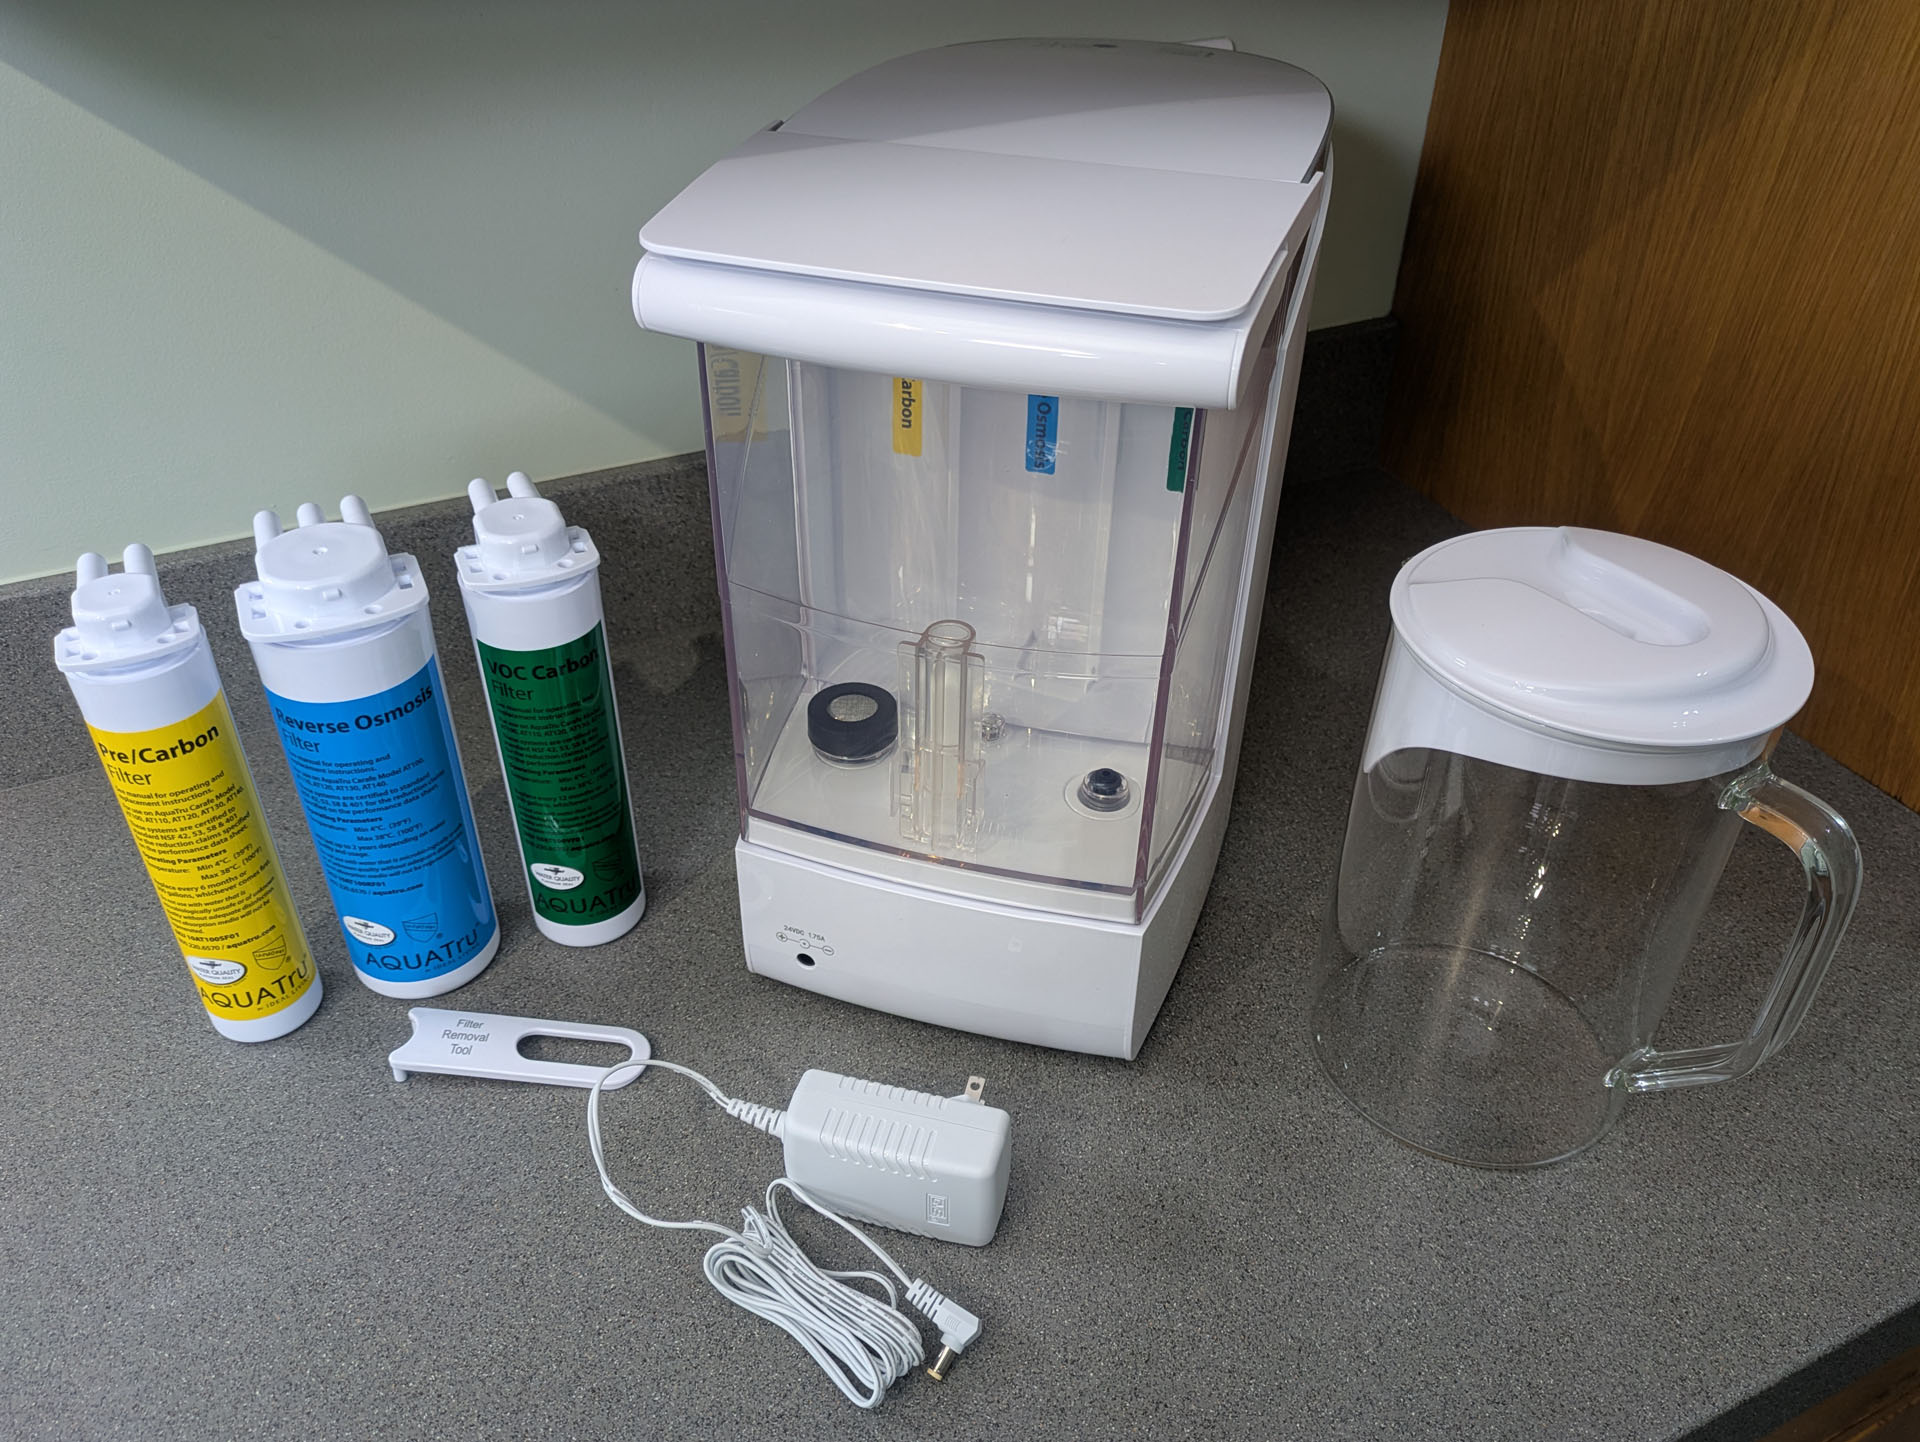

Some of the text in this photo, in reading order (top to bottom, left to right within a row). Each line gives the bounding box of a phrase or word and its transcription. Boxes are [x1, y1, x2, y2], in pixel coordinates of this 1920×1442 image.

[902, 378, 916, 429] arbon
[1034, 402, 1052, 469] Osmosis
[487, 647, 598, 681] VOC Carbon
[492, 679, 534, 701] Filter
[276, 685, 433, 734] Reverse Osmosis
[97, 725, 220, 765] Pre/Carbon
[282, 727, 320, 753] Filter
[106, 763, 153, 786] Filter
[169, 781, 211, 800] operating
[211, 770, 225, 783] and
[155, 806, 189, 818] AquaTru
[189, 797, 215, 811] Carafe
[215, 783, 237, 801] Model
[162, 788, 214, 807] instructions.
[172, 813, 200, 824] AT120,
[201, 801, 226, 818] AT130,
[180, 824, 193, 832] are
[194, 811, 228, 829] certified
[161, 833, 176, 841] NSF
[178, 832, 191, 841] 42,
[195, 831, 221, 844] claims
[158, 844, 209, 856] performance
[210, 837, 228, 849] data
[177, 848, 227, 864] Parameters
[196, 864, 214, 872] Min
[201, 873, 219, 881] Max
[207, 875, 239, 890] months
[554, 875, 581, 883] QUALITY
[195, 884, 237, 899] whichever
[226, 924, 277, 949] aquatru.com
[364, 930, 391, 939] QUALITY
[783, 924, 826, 943] 24VDC 1.75A
[366, 929, 478, 971] AQUATru
[212, 967, 242, 977] QUALITY
[200, 960, 308, 1009] AQUATru
[456, 1018, 485, 1030] Filter
[441, 1028, 490, 1043] Removal
[451, 1042, 473, 1056] Tool
